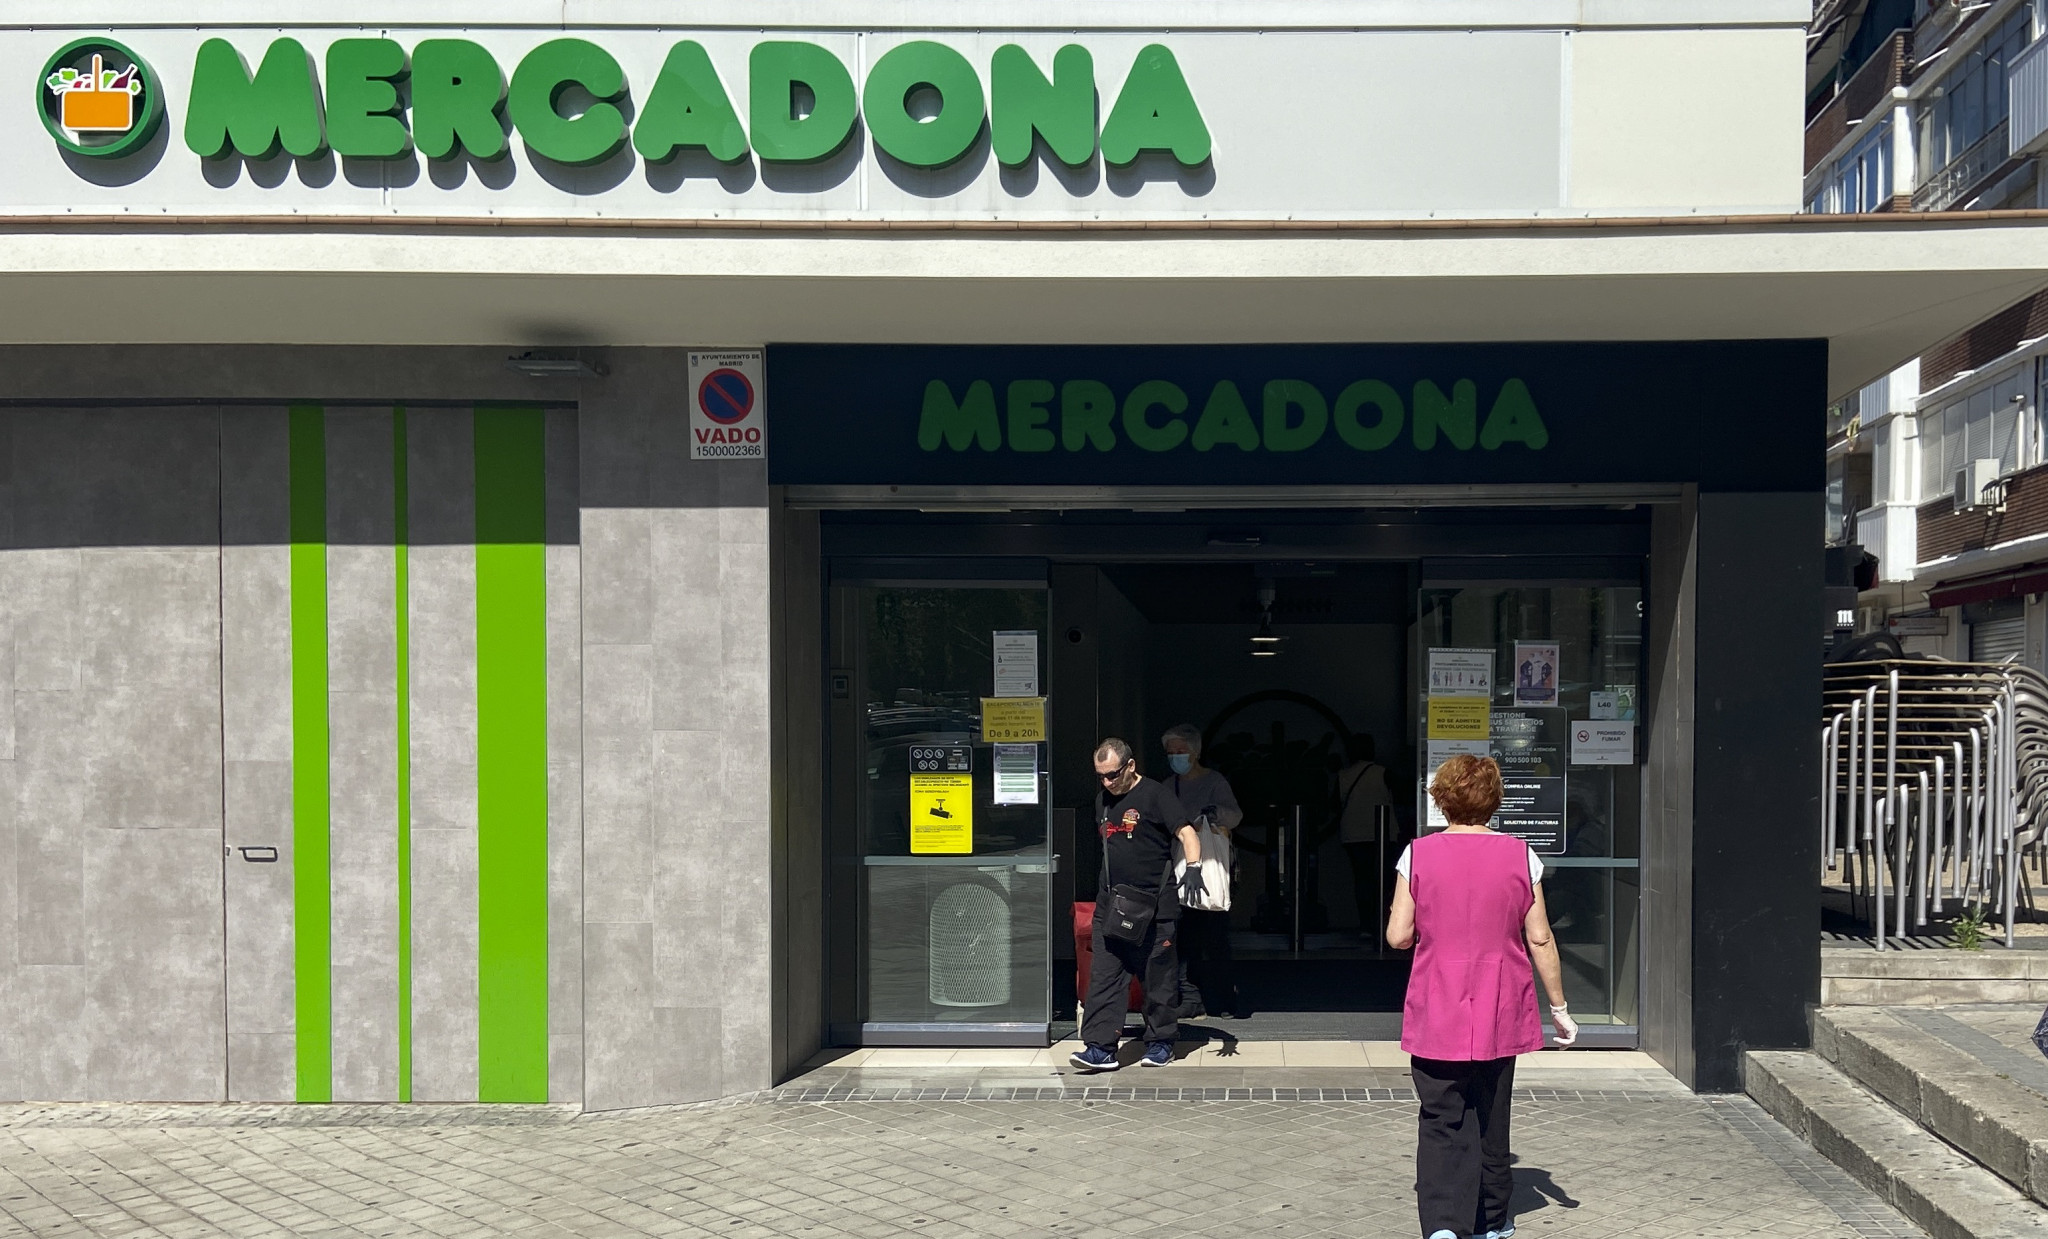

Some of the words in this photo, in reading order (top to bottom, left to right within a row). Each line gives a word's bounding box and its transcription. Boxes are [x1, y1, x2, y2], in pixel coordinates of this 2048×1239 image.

[184, 36, 1212, 168] MERCADONA
[917, 378, 1549, 452] MERCADONA
[694, 427, 761, 444] VADO
[696, 445, 761, 457] 1500002366
[1004, 729, 1011, 738] 9
[1021, 729, 1039, 737] 20h
